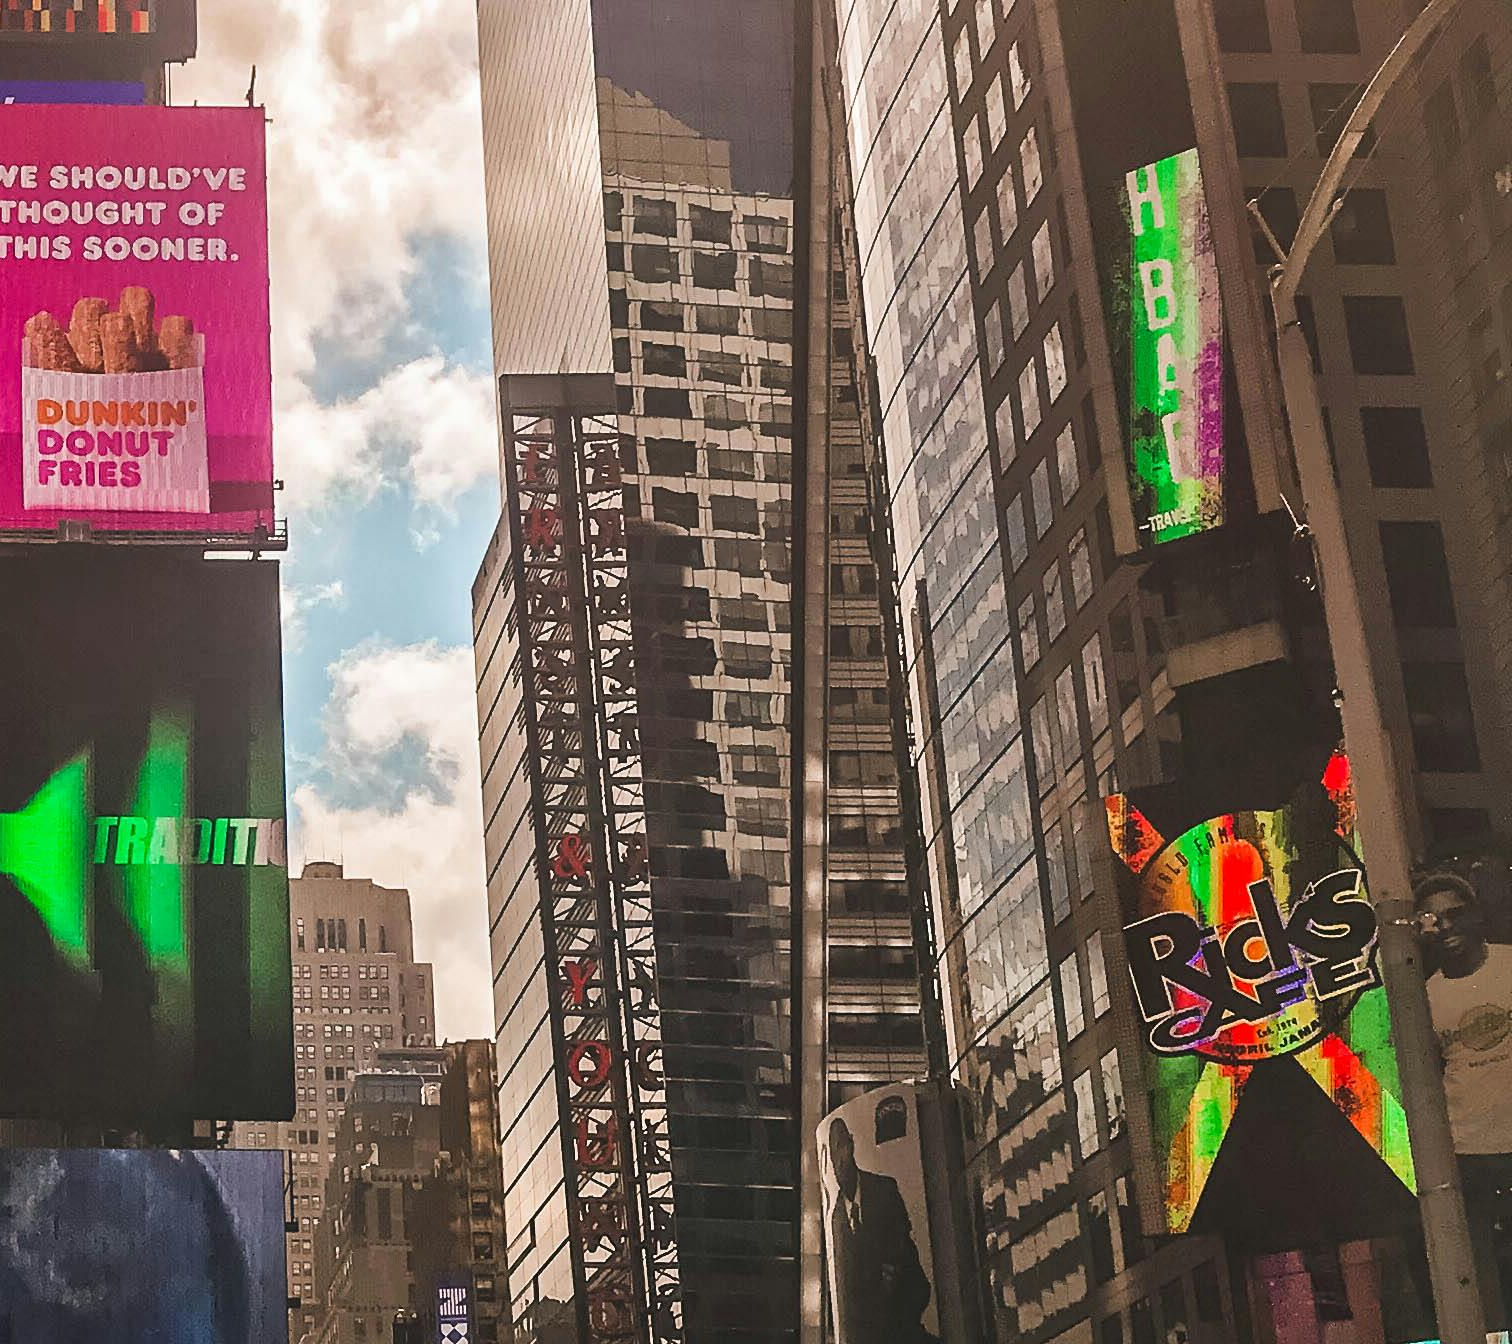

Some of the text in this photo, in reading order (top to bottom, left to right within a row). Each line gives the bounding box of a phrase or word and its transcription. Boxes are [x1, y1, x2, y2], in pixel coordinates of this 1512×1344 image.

[49, 166, 246, 191] SHOULD'VE
[178, 202, 225, 226] OF
[82, 237, 239, 262] SOONER.
[37, 398, 198, 426] DUNKIN'
[38, 429, 174, 457] DONUT
[38, 460, 142, 487] FRIES
